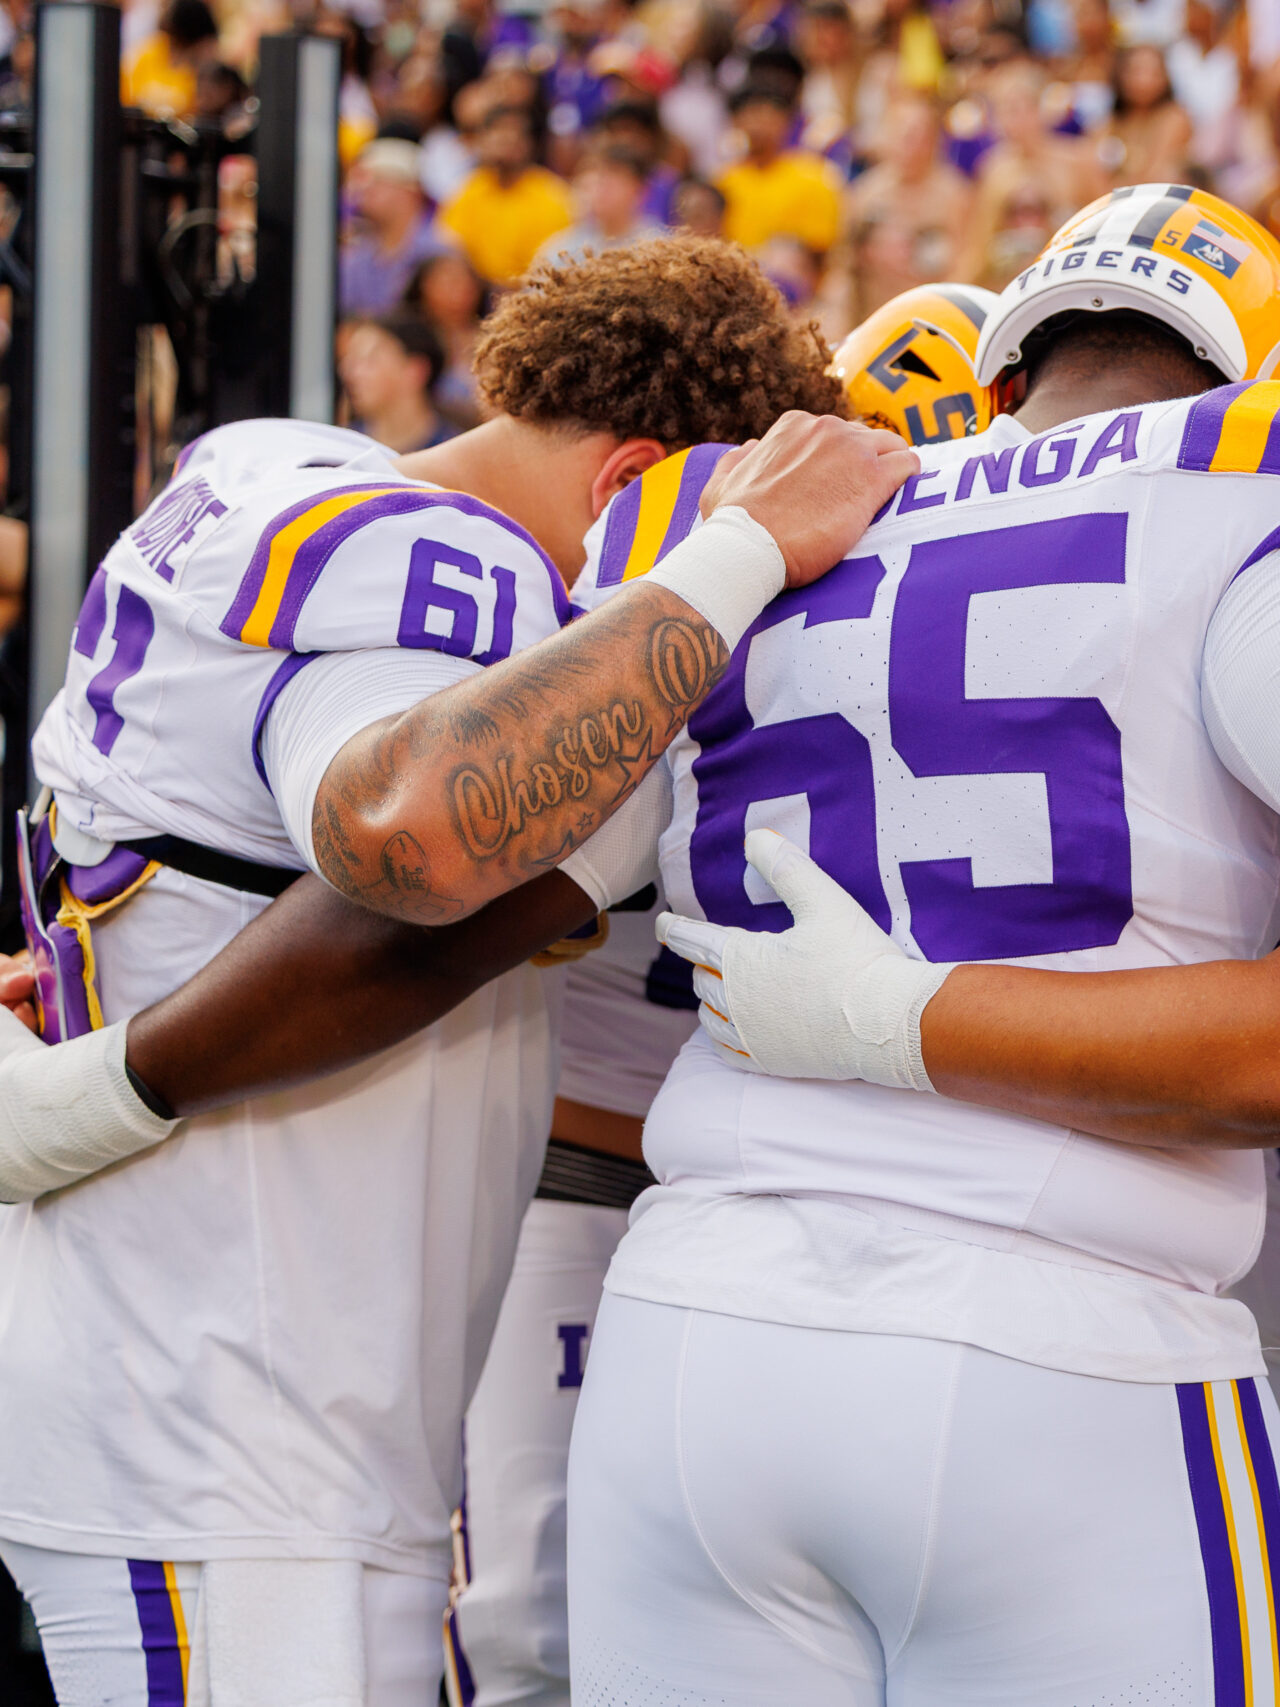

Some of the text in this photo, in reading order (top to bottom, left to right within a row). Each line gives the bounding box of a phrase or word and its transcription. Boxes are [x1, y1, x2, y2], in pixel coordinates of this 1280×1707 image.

[1018, 250, 1193, 295] TIGERS
[866, 327, 977, 447] LS
[869, 411, 1143, 526] ENGA
[397, 537, 517, 667] 61
[452, 696, 643, 860] Chosen
[688, 512, 1134, 963] 65
